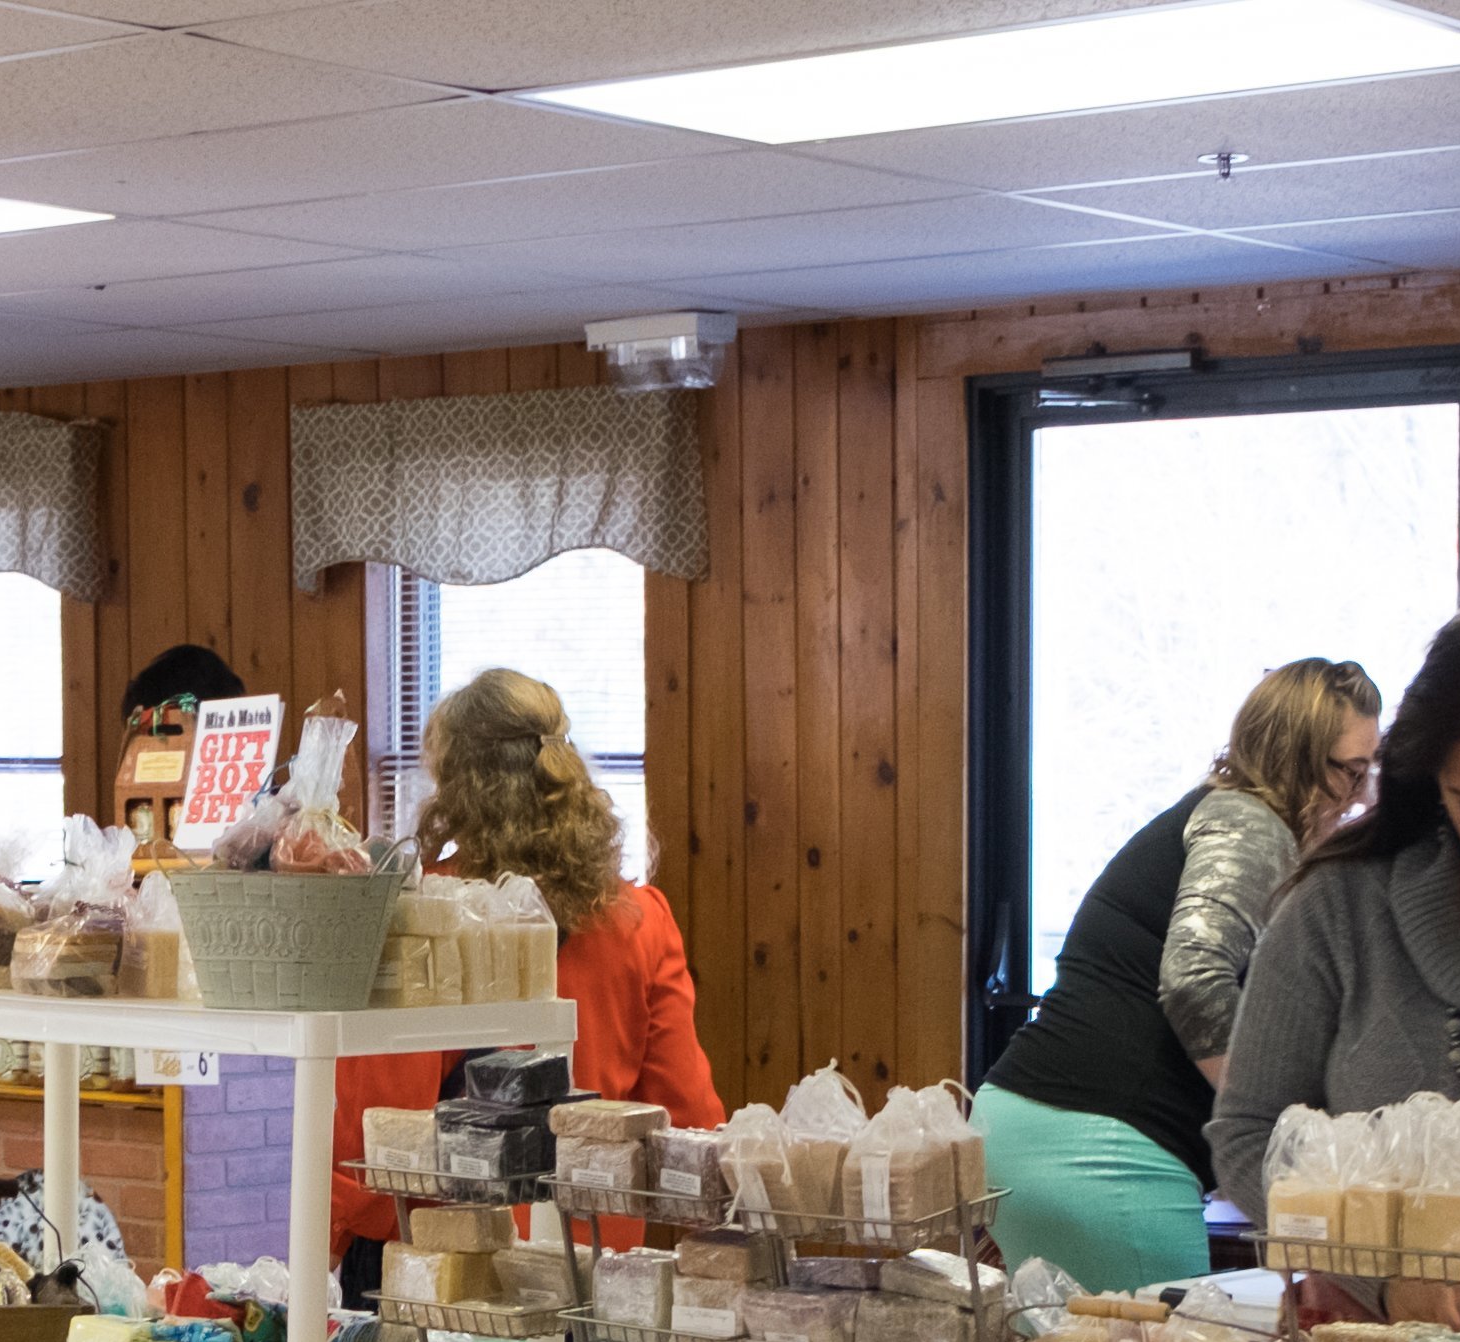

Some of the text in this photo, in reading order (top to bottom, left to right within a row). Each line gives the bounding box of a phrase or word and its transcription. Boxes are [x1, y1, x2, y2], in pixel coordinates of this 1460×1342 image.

[204, 711, 224, 729] Mix
[238, 706, 272, 726] Match
[200, 730, 271, 764] GIFT
[193, 762, 266, 795] BOX
[185, 793, 245, 824] SET
